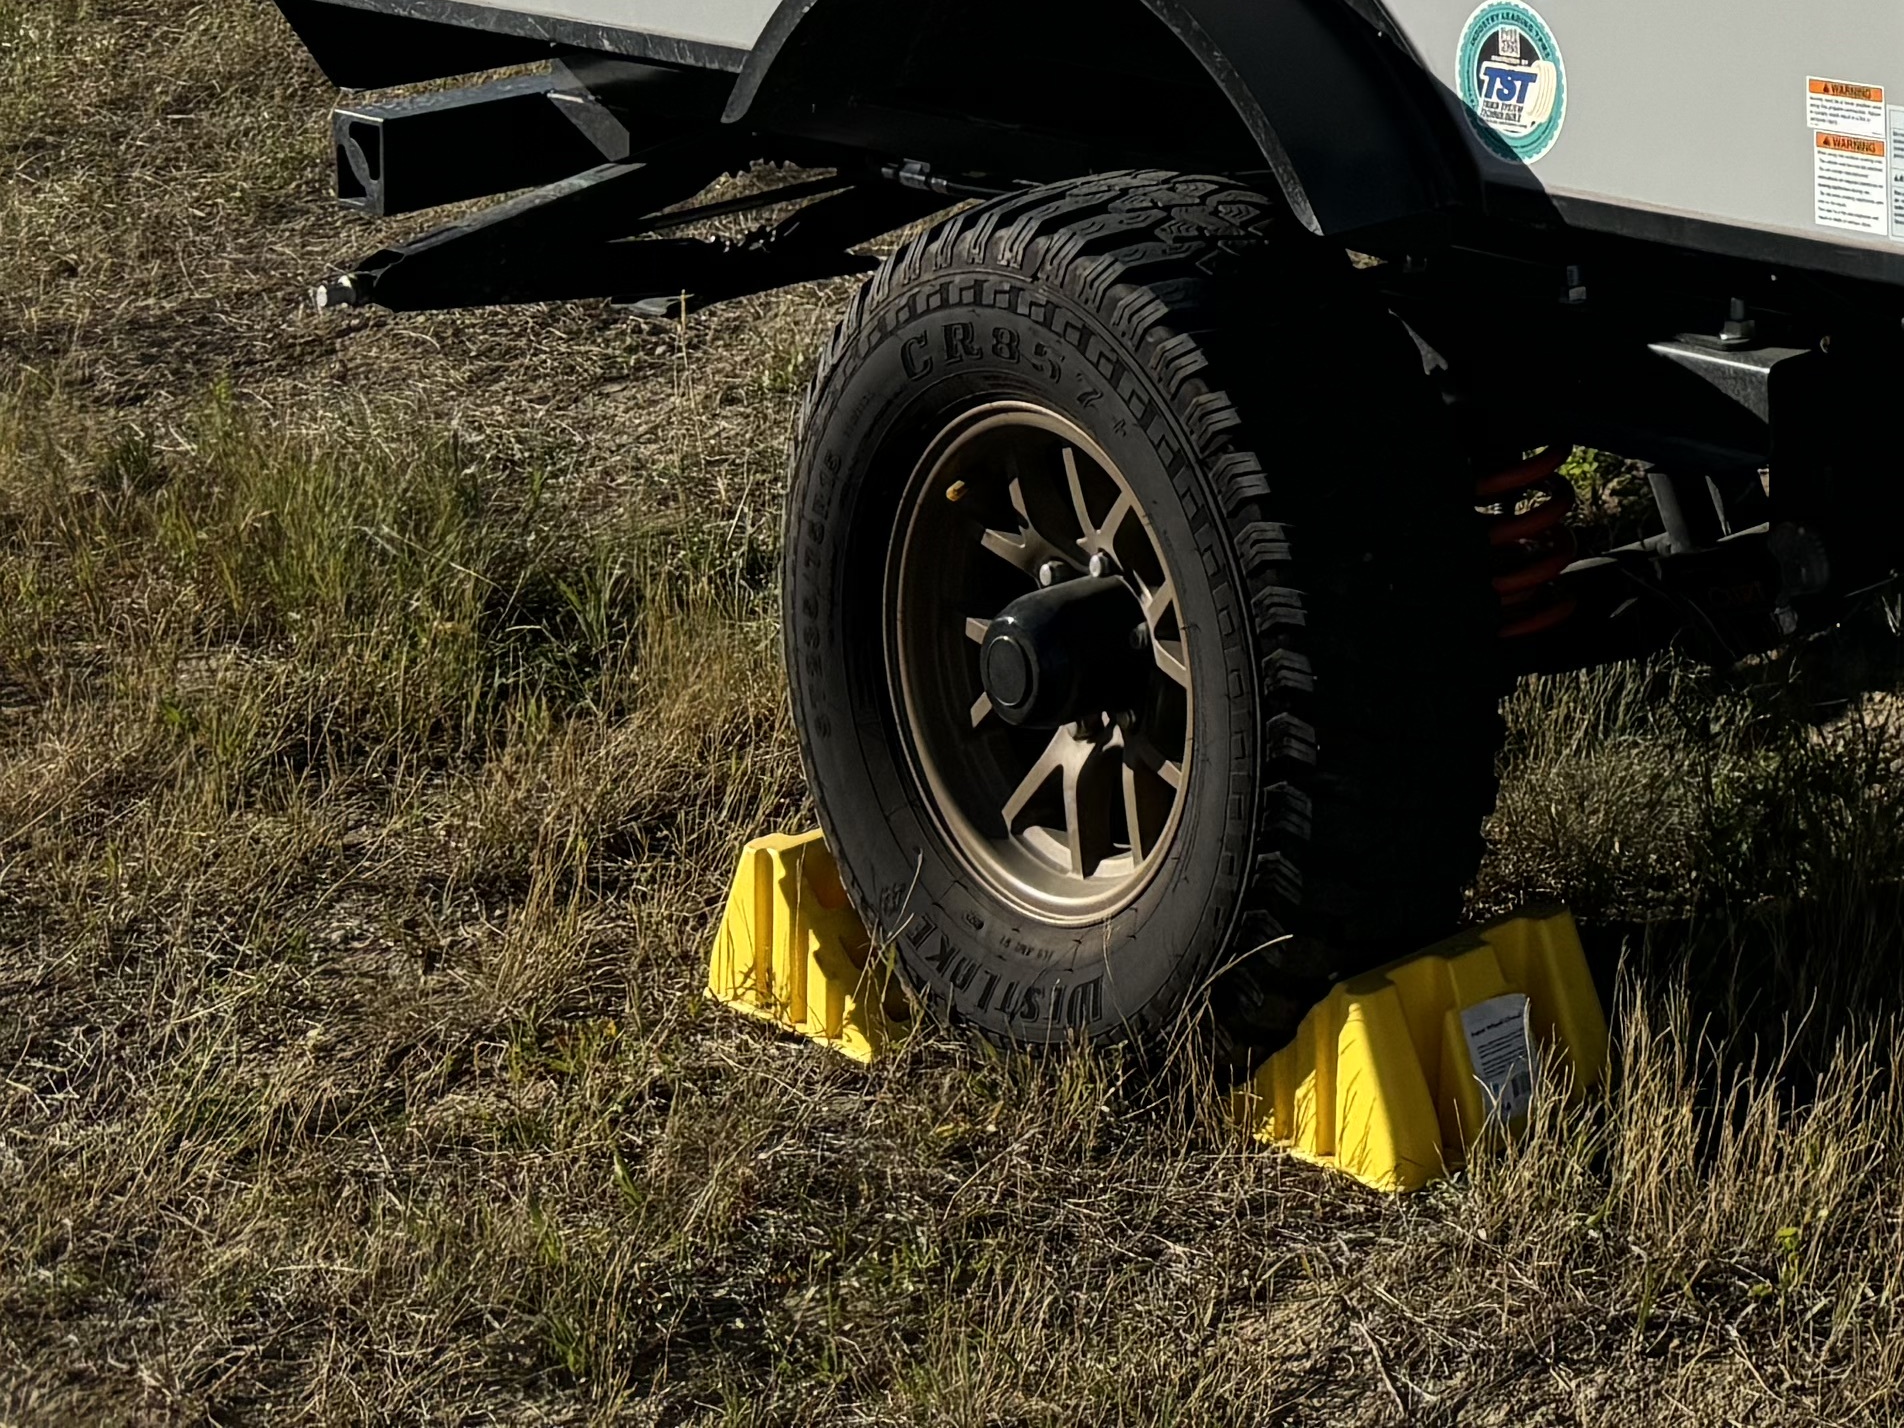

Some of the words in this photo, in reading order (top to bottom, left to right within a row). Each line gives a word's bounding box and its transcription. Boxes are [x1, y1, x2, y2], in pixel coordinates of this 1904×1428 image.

[1483, 67, 1538, 104] TST
[1831, 84, 1872, 101] WARNING
[1832, 137, 1877, 154] WARNING
